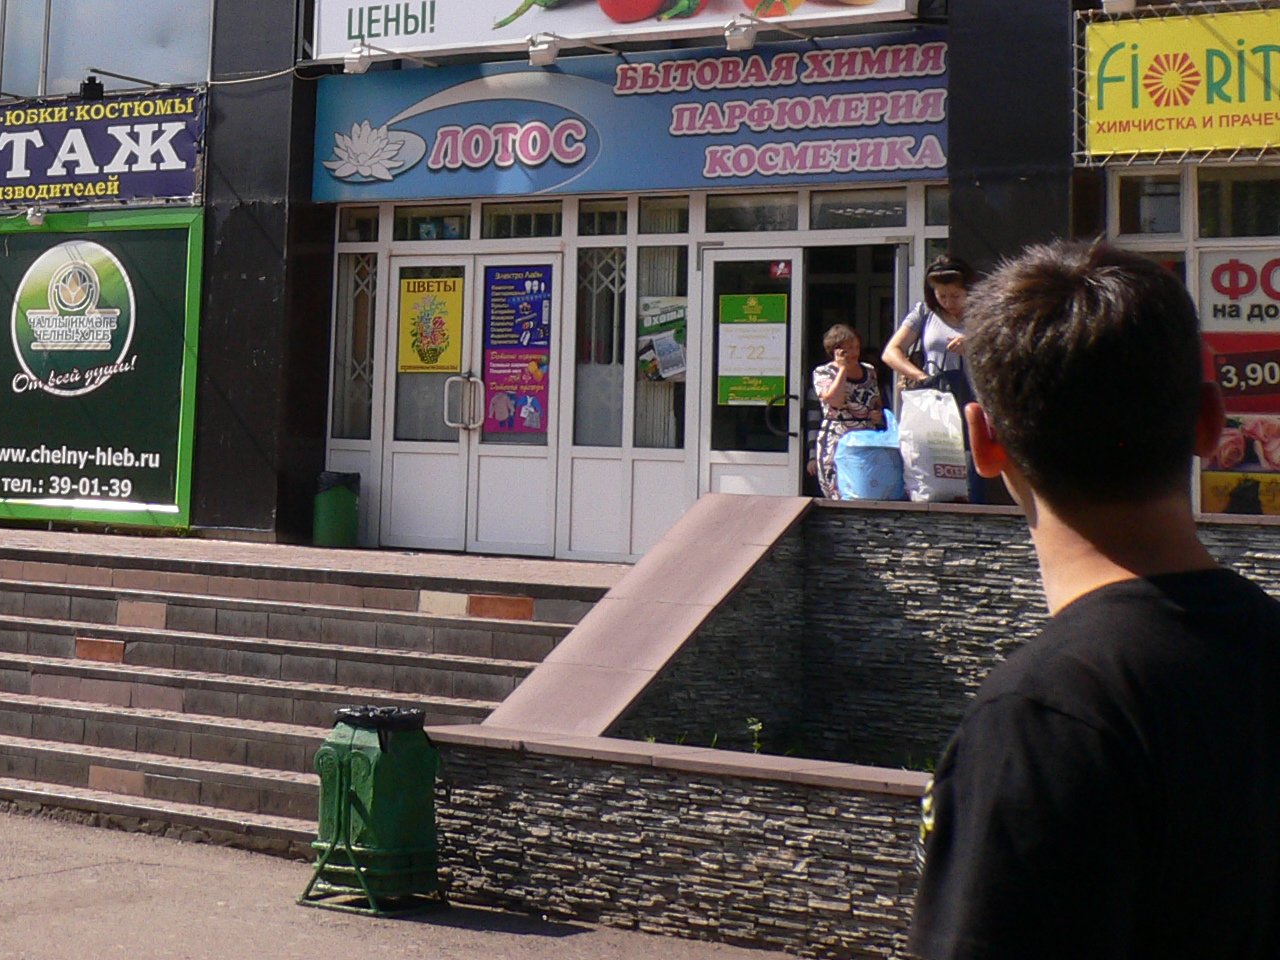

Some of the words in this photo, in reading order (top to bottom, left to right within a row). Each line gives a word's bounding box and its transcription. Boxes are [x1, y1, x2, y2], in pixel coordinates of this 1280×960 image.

[346, 0, 436, 41] ЦЕНЫ!
[614, 51, 798, 94] БЫТОВАЯ
[803, 43, 948, 79] ХИМИЯ
[4, 106, 68, 127] ЮБКИ
[75, 96, 195, 121] КОСТЮМЫ
[670, 89, 948, 135] ПАРФЮМЕРИЯ
[1096, 116, 1197, 134] ХИМЧИСТКА
[1203, 116, 1213, 129] И
[428, 118, 587, 169] ЛОТОС
[703, 136, 948, 178] КОСМЕТИКА
[406, 280, 456, 294] ЦВЕТЫ
[28, 316, 69, 329] ЧАЛЛЫ
[1213, 304, 1241, 319] на
[12, 373, 43, 393] От
[48, 368, 81, 386] всей
[85, 355, 137, 386] души!
[1221, 361, 1280, 391] 3,90
[1, 477, 44, 493] тел.:
[49, 476, 132, 497] 39-01-39
